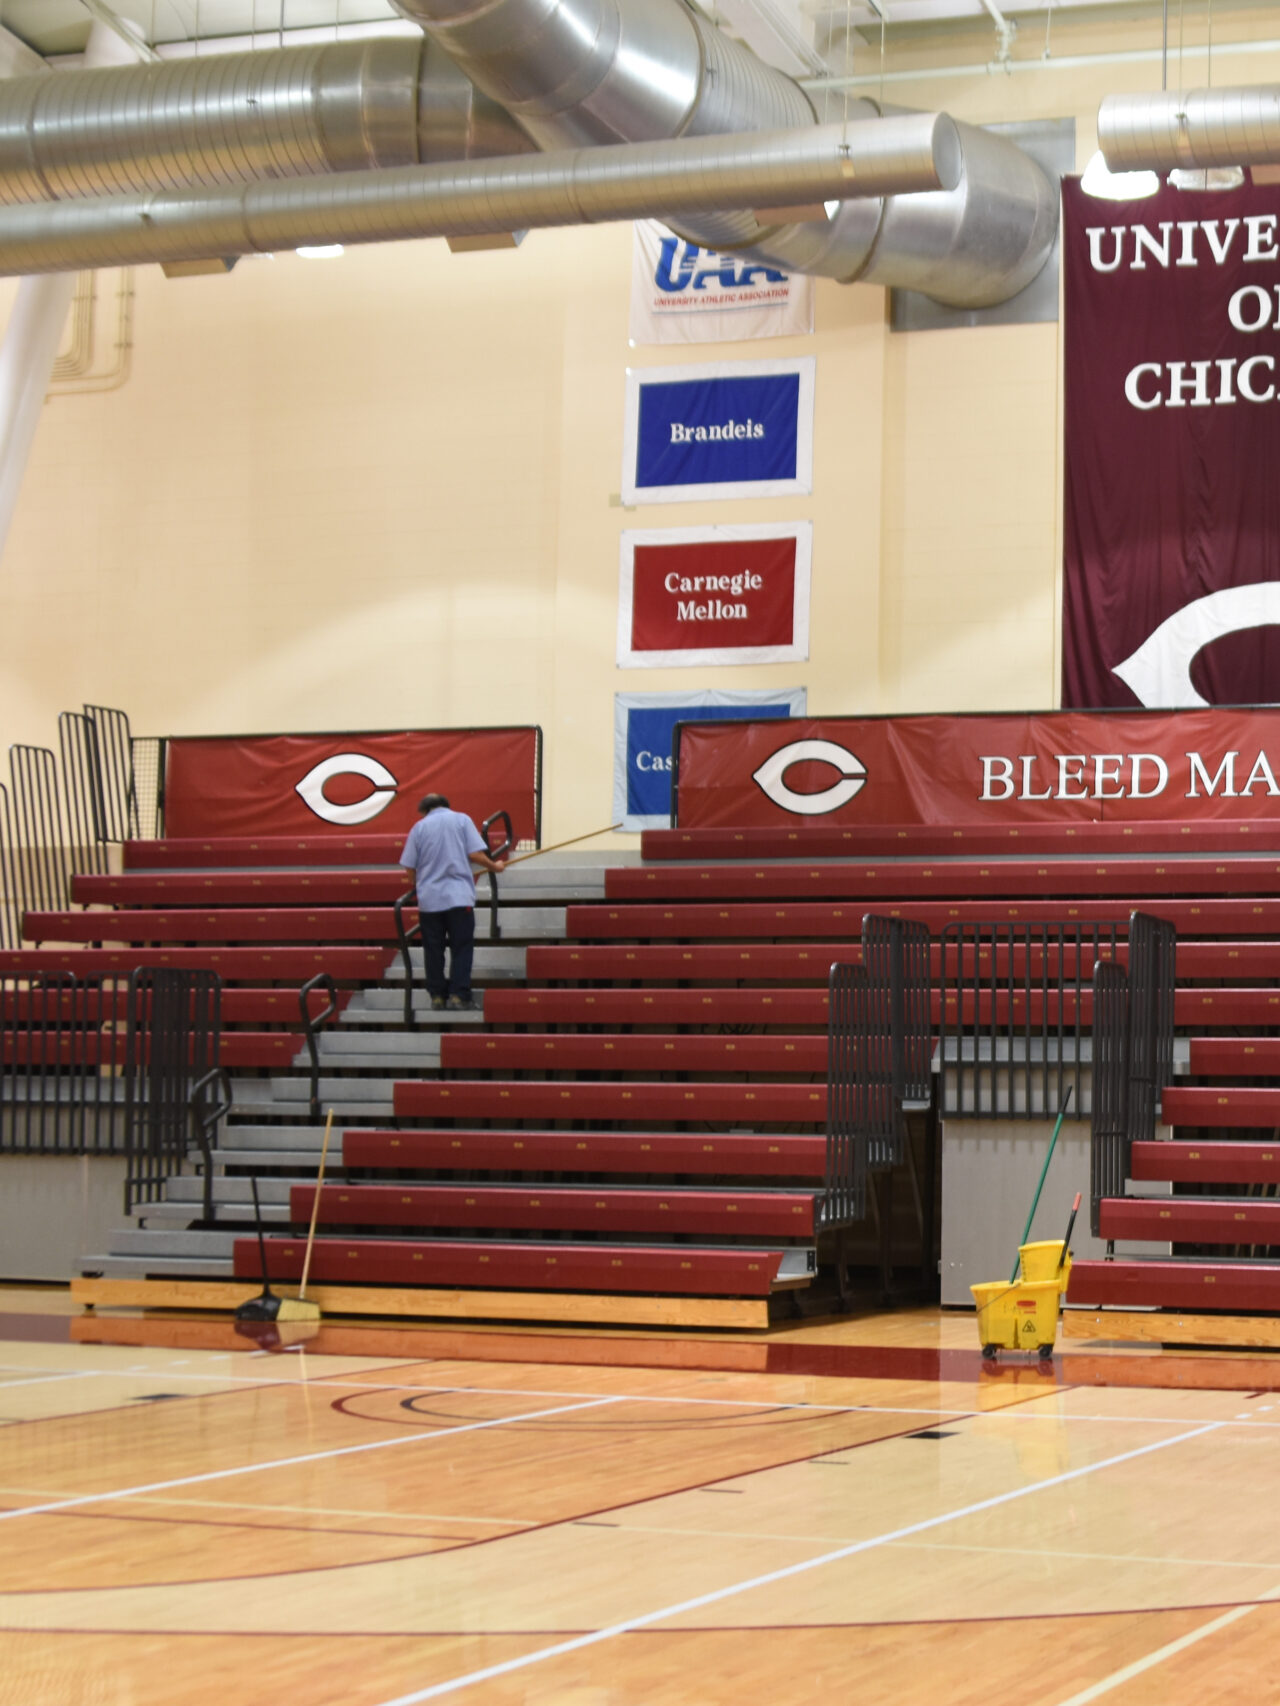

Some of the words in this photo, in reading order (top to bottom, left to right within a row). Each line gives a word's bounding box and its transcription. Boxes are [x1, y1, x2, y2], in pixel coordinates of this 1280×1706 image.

[654, 295, 698, 306] UNIVERSITY
[700, 293, 736, 305] ATHLETIC
[738, 287, 790, 301] ASSOCIATION
[670, 418, 764, 443] Brandeis
[664, 569, 763, 594] Carnegie
[676, 599, 748, 621] Mellon
[636, 750, 678, 771] Cas
[978, 752, 1170, 801] BLEED
